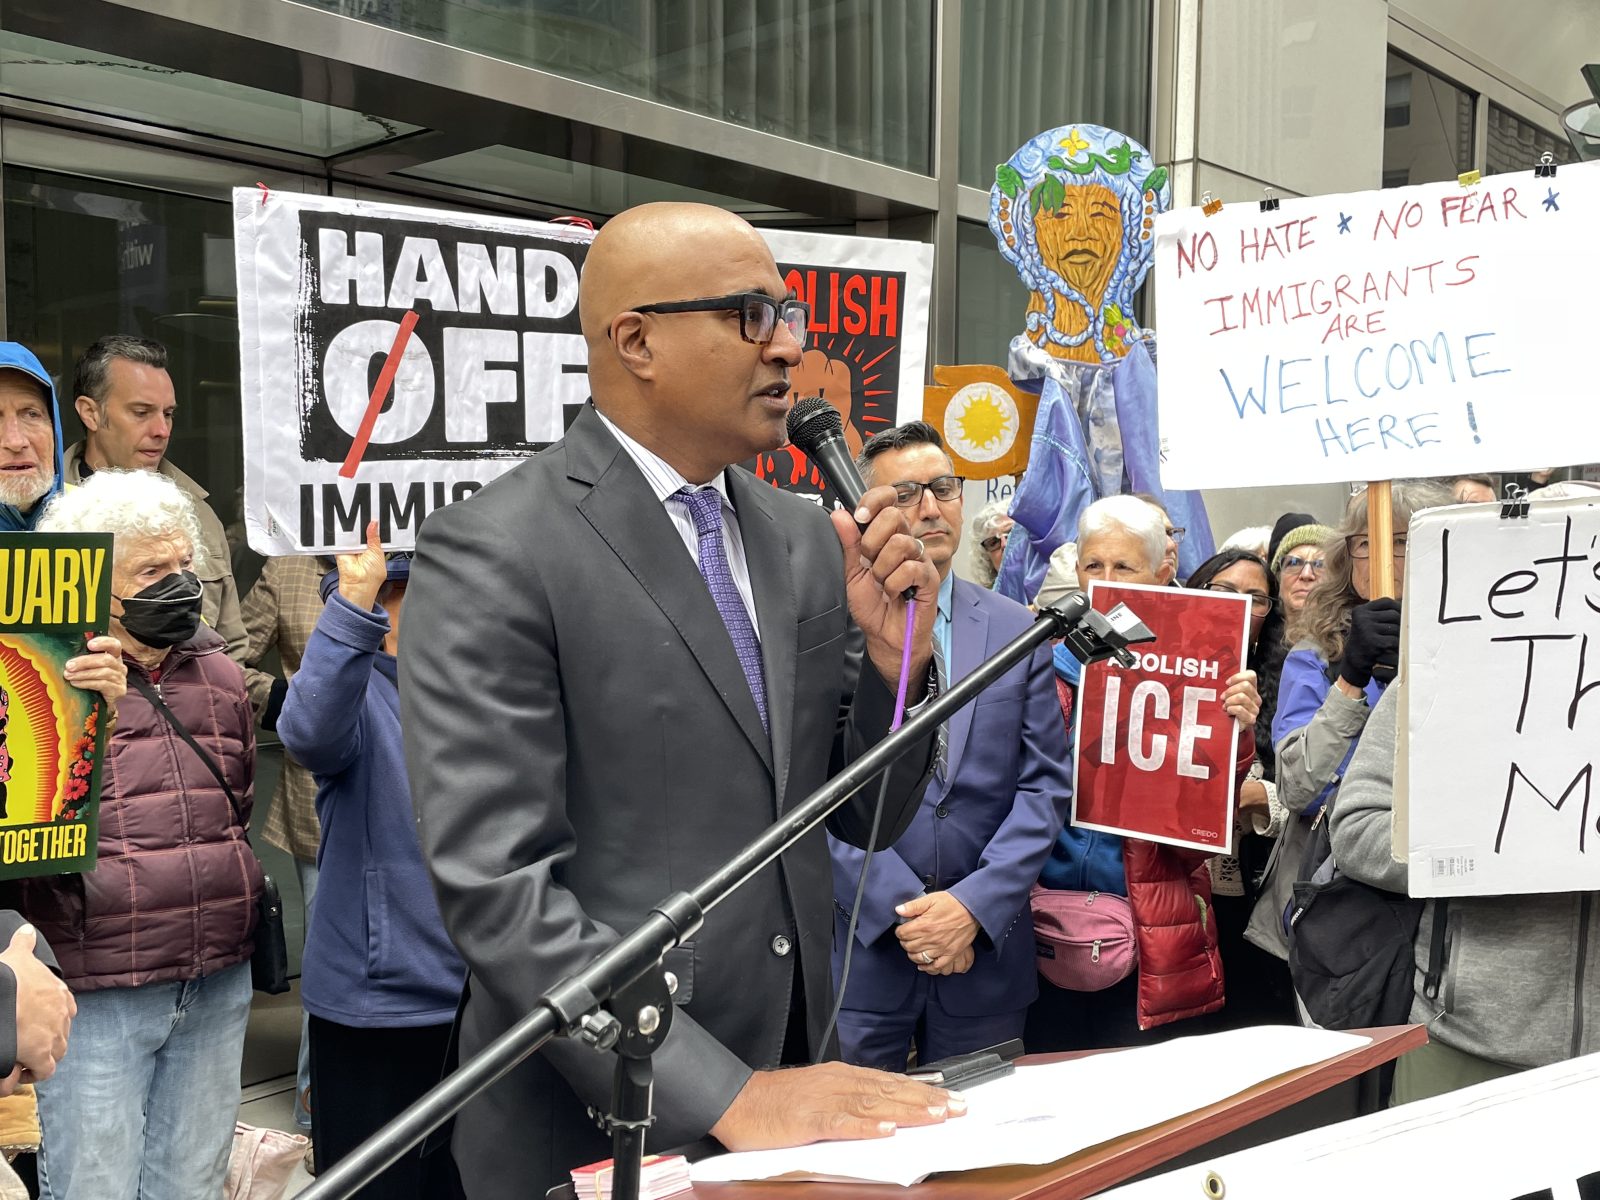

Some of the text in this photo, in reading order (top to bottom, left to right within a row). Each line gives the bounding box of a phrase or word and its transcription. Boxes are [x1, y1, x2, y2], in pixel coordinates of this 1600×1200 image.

[318, 227, 585, 319] HAND
[1177, 187, 1528, 278] NO HATE NO FEAR
[1203, 255, 1480, 336] IMMIGRANTS
[1321, 310, 1386, 345] ARE
[323, 320, 589, 443] OFF
[1219, 331, 1512, 419] WELCOME
[1315, 412, 1442, 457] HERE
[986, 476, 1017, 503] Re
[0, 548, 106, 625] UARY
[1101, 675, 1217, 780] ICE
[1191, 828, 1217, 838] CREDO
[1494, 761, 1600, 854] M
